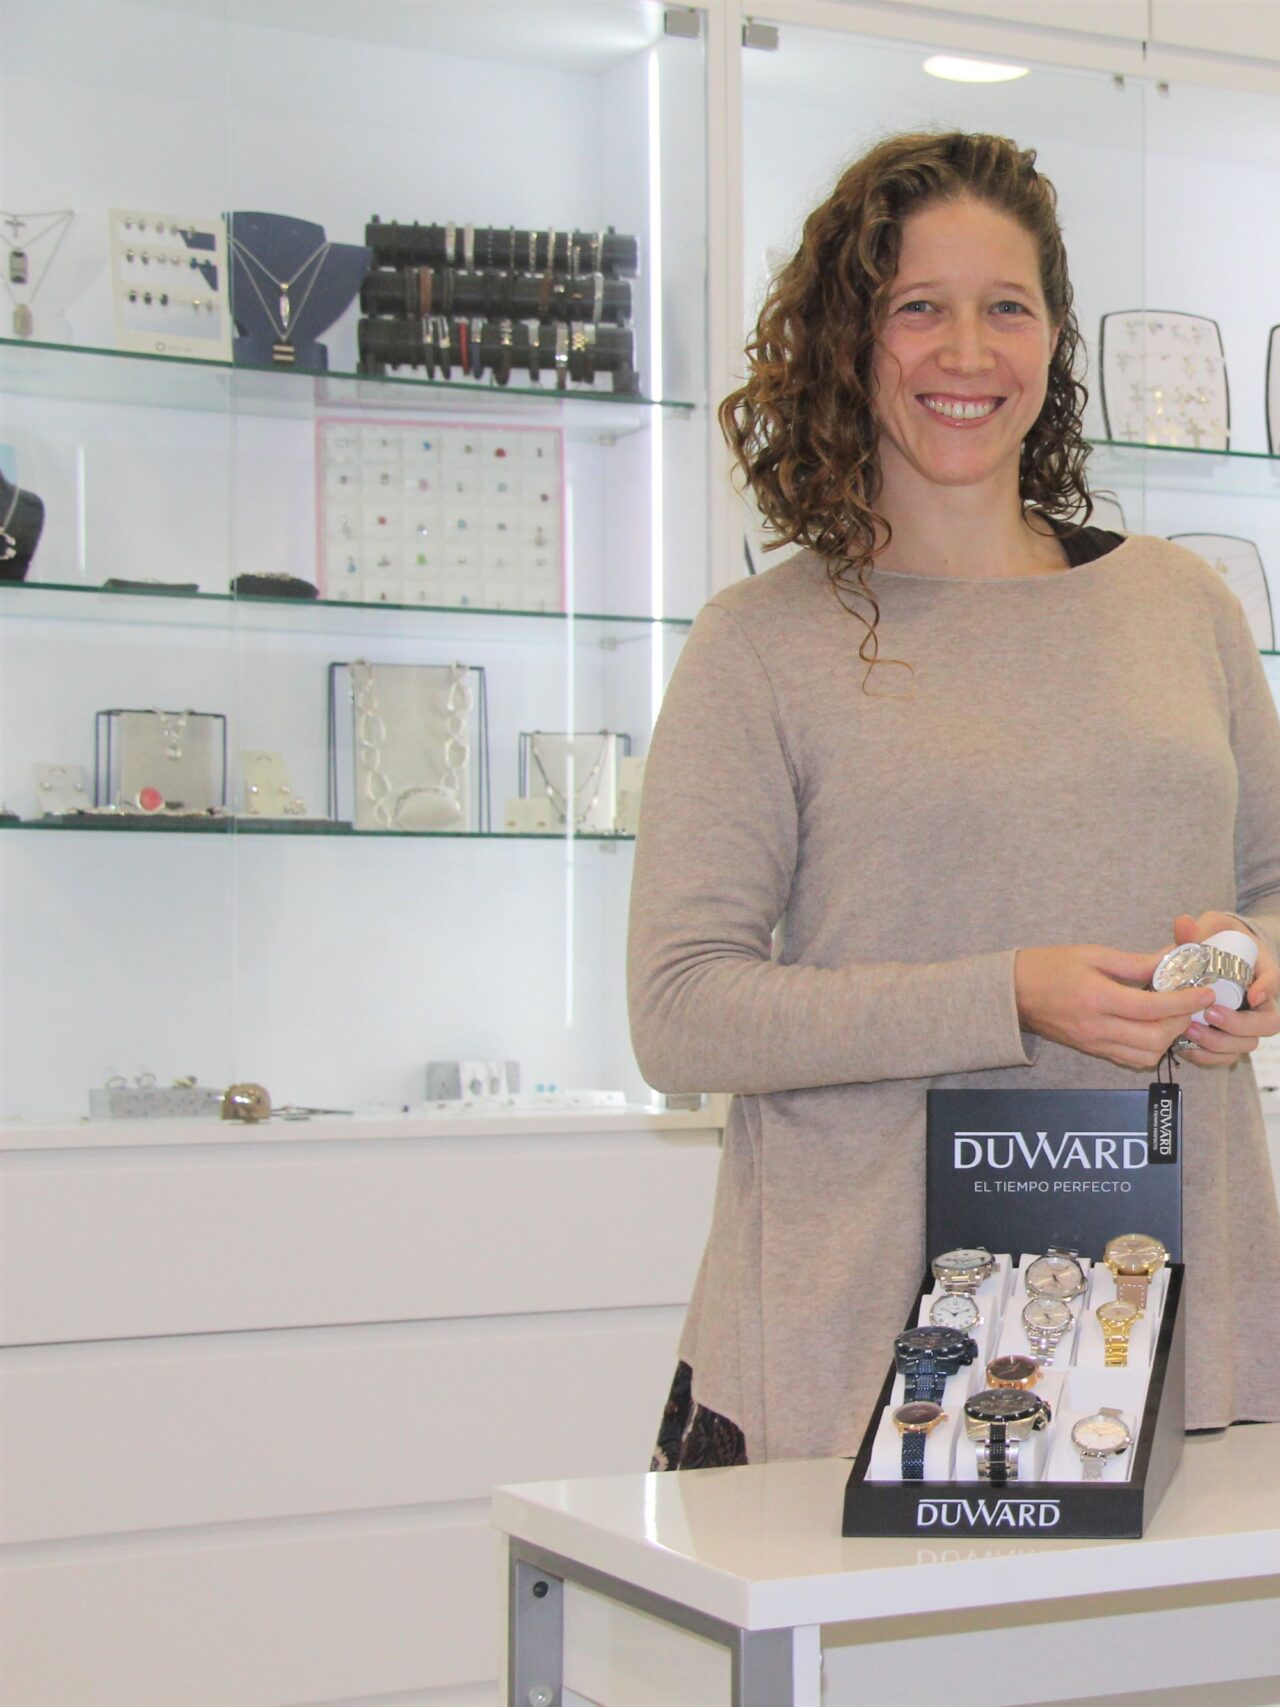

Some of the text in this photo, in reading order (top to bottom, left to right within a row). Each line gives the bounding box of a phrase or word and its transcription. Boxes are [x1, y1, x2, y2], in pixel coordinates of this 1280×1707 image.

[1160, 1099, 1172, 1155] DUWARD
[954, 1131, 1149, 1169] DUWARD
[974, 1181, 1131, 1193] EL TIEMPO PERFECTO
[916, 1499, 1061, 1528] DUWARD
